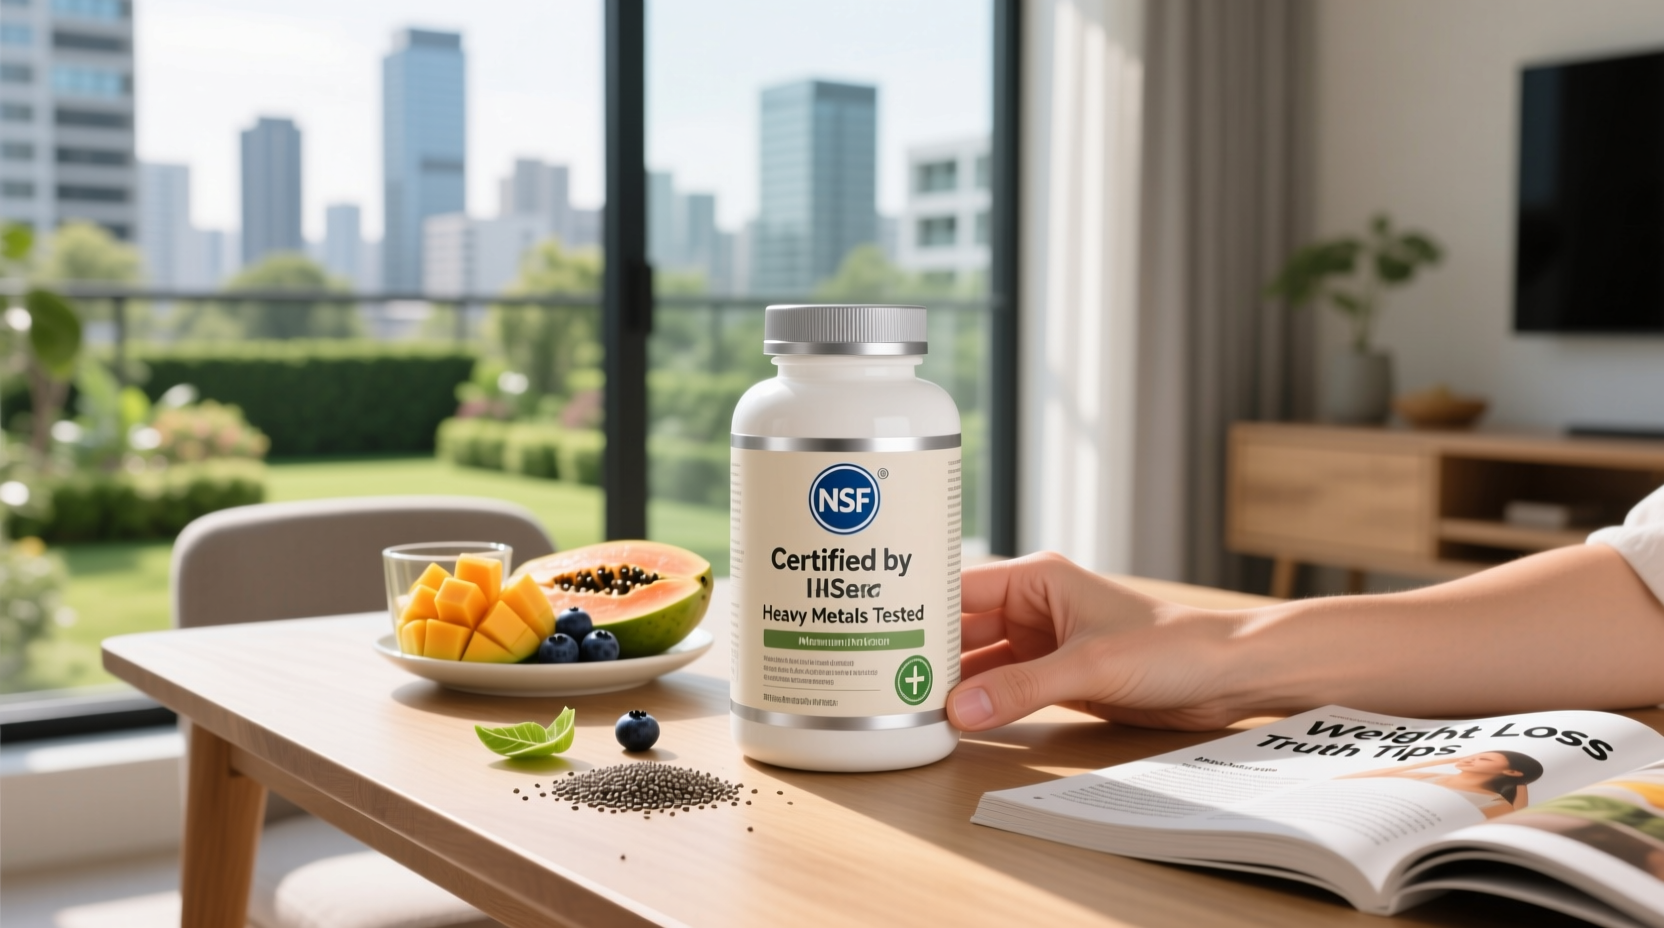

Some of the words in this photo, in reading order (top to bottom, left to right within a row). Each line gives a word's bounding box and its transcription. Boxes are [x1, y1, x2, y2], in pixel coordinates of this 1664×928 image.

[819, 487, 871, 513] NSF
[771, 547, 876, 571] Certified
[884, 547, 912, 577] by
[763, 604, 807, 626] Heavy
[812, 607, 868, 623] Metals
[872, 604, 924, 623] Tested
[1306, 720, 1484, 744] Weight
[1256, 734, 1361, 757] Truth
[1372, 743, 1462, 761] Tips
